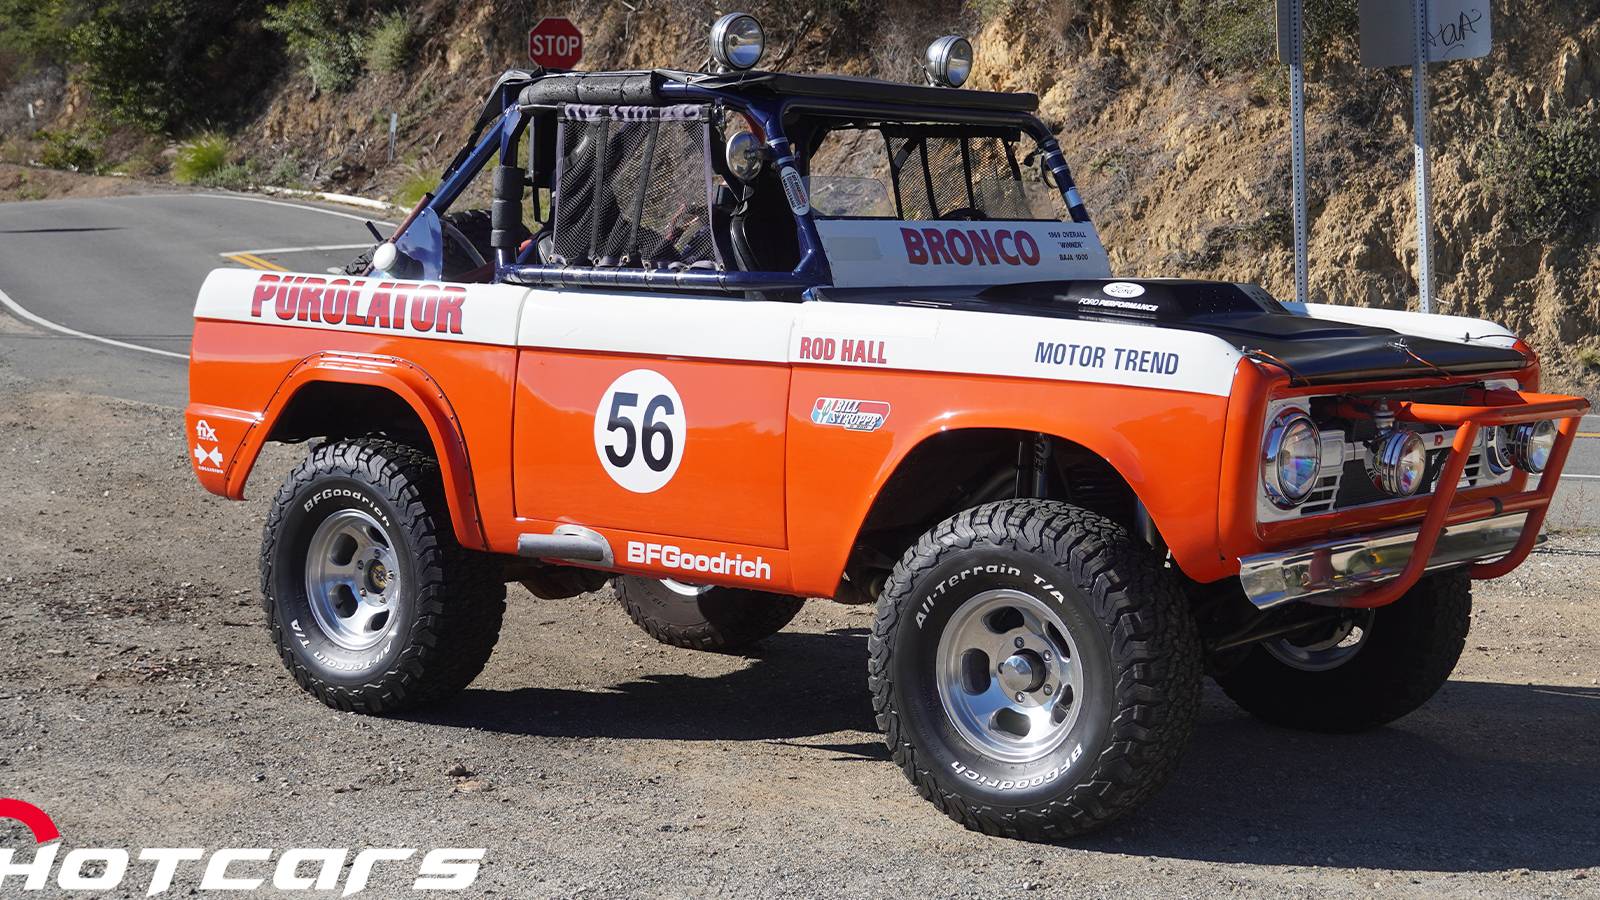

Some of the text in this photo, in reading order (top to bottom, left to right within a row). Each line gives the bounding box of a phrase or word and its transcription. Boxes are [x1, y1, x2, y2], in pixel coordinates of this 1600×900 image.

[532, 35, 580, 57] STOP
[900, 227, 1041, 267] BRONCO
[1062, 231, 1087, 239] OVERALL
[1059, 253, 1074, 261] BAJA
[251, 274, 468, 335] PUROLATOR
[1078, 297, 1159, 312] FORD PERFORMANCE
[799, 336, 887, 365] ROD HALL
[1034, 341, 1180, 376] MOTOR TREND
[830, 412, 881, 427] STROPPE
[834, 399, 861, 414] BILL
[604, 391, 675, 473] 56
[303, 488, 391, 528] BFGoodrich
[627, 540, 772, 580] BFGoodrich
[915, 563, 1065, 630] All-Terrain T/A
[290, 619, 311, 649] T/A
[951, 743, 1083, 790] BFGoodrich
